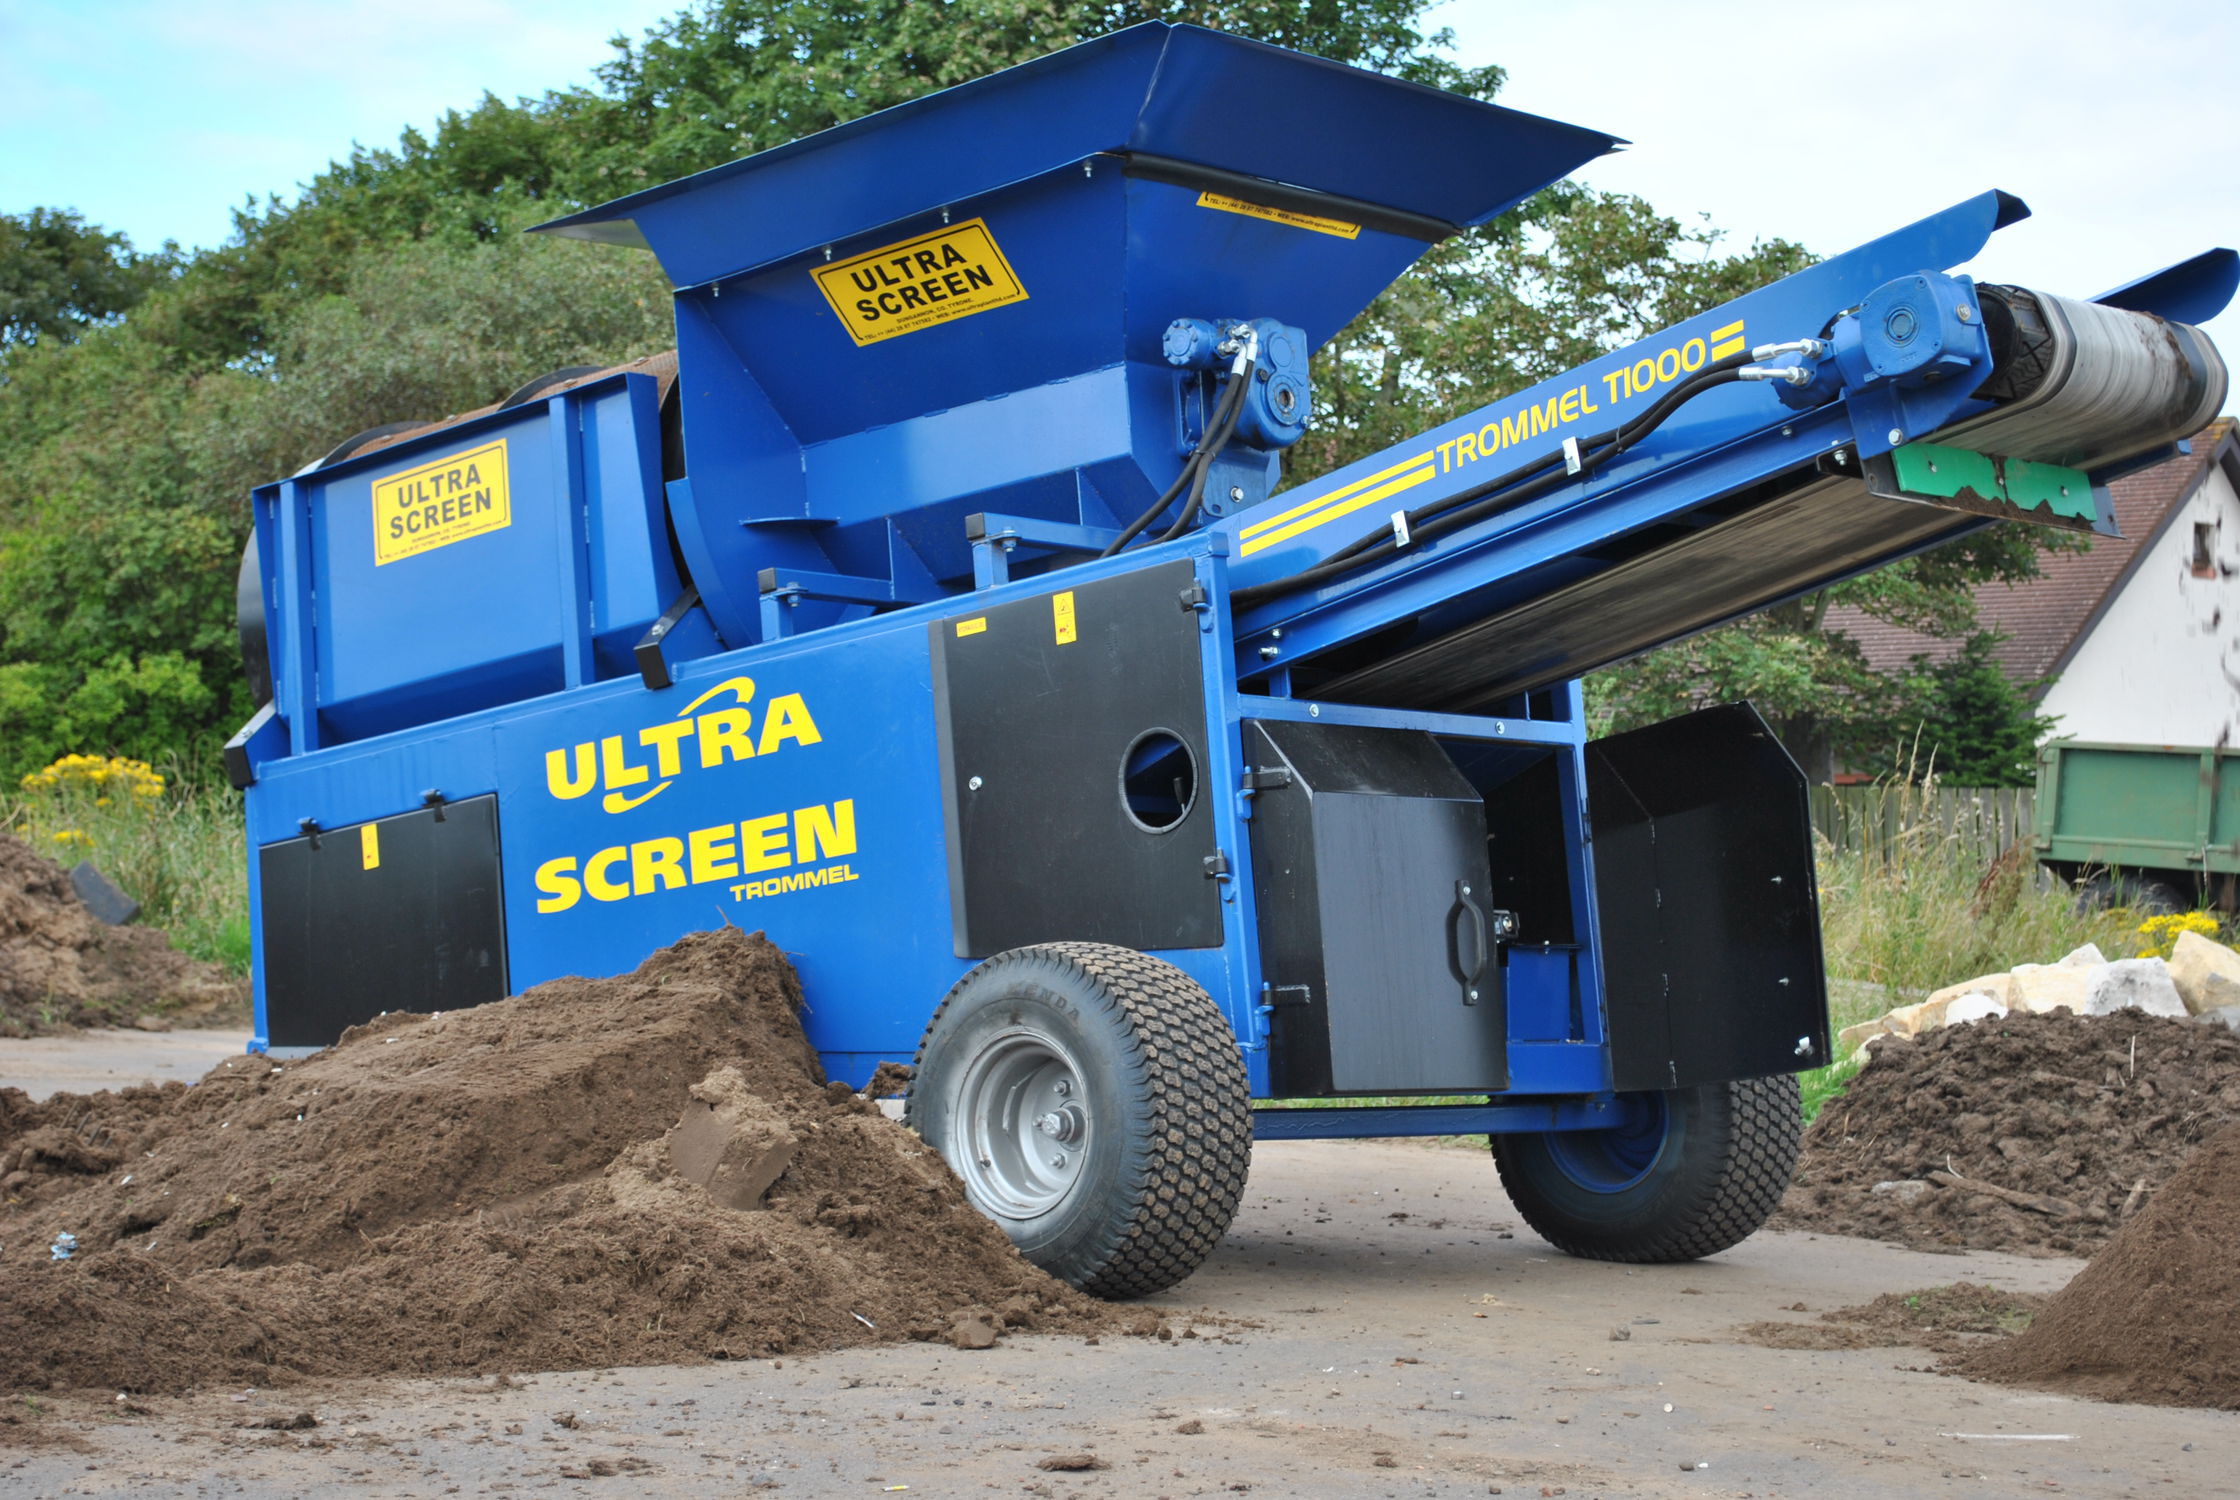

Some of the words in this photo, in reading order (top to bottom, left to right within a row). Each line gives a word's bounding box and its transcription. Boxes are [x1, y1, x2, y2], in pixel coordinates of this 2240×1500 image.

[850, 243, 967, 292] ULTRA
[856, 264, 994, 321] SCREEN
[1436, 384, 1598, 473] TROMMEL
[1603, 337, 1706, 404] T1000
[390, 487, 491, 539] SCREEN
[398, 463, 481, 509] ULTRA
[545, 692, 823, 800] ULTRA
[534, 798, 857, 914] SCREEN
[729, 864, 859, 902] TROMMEL
